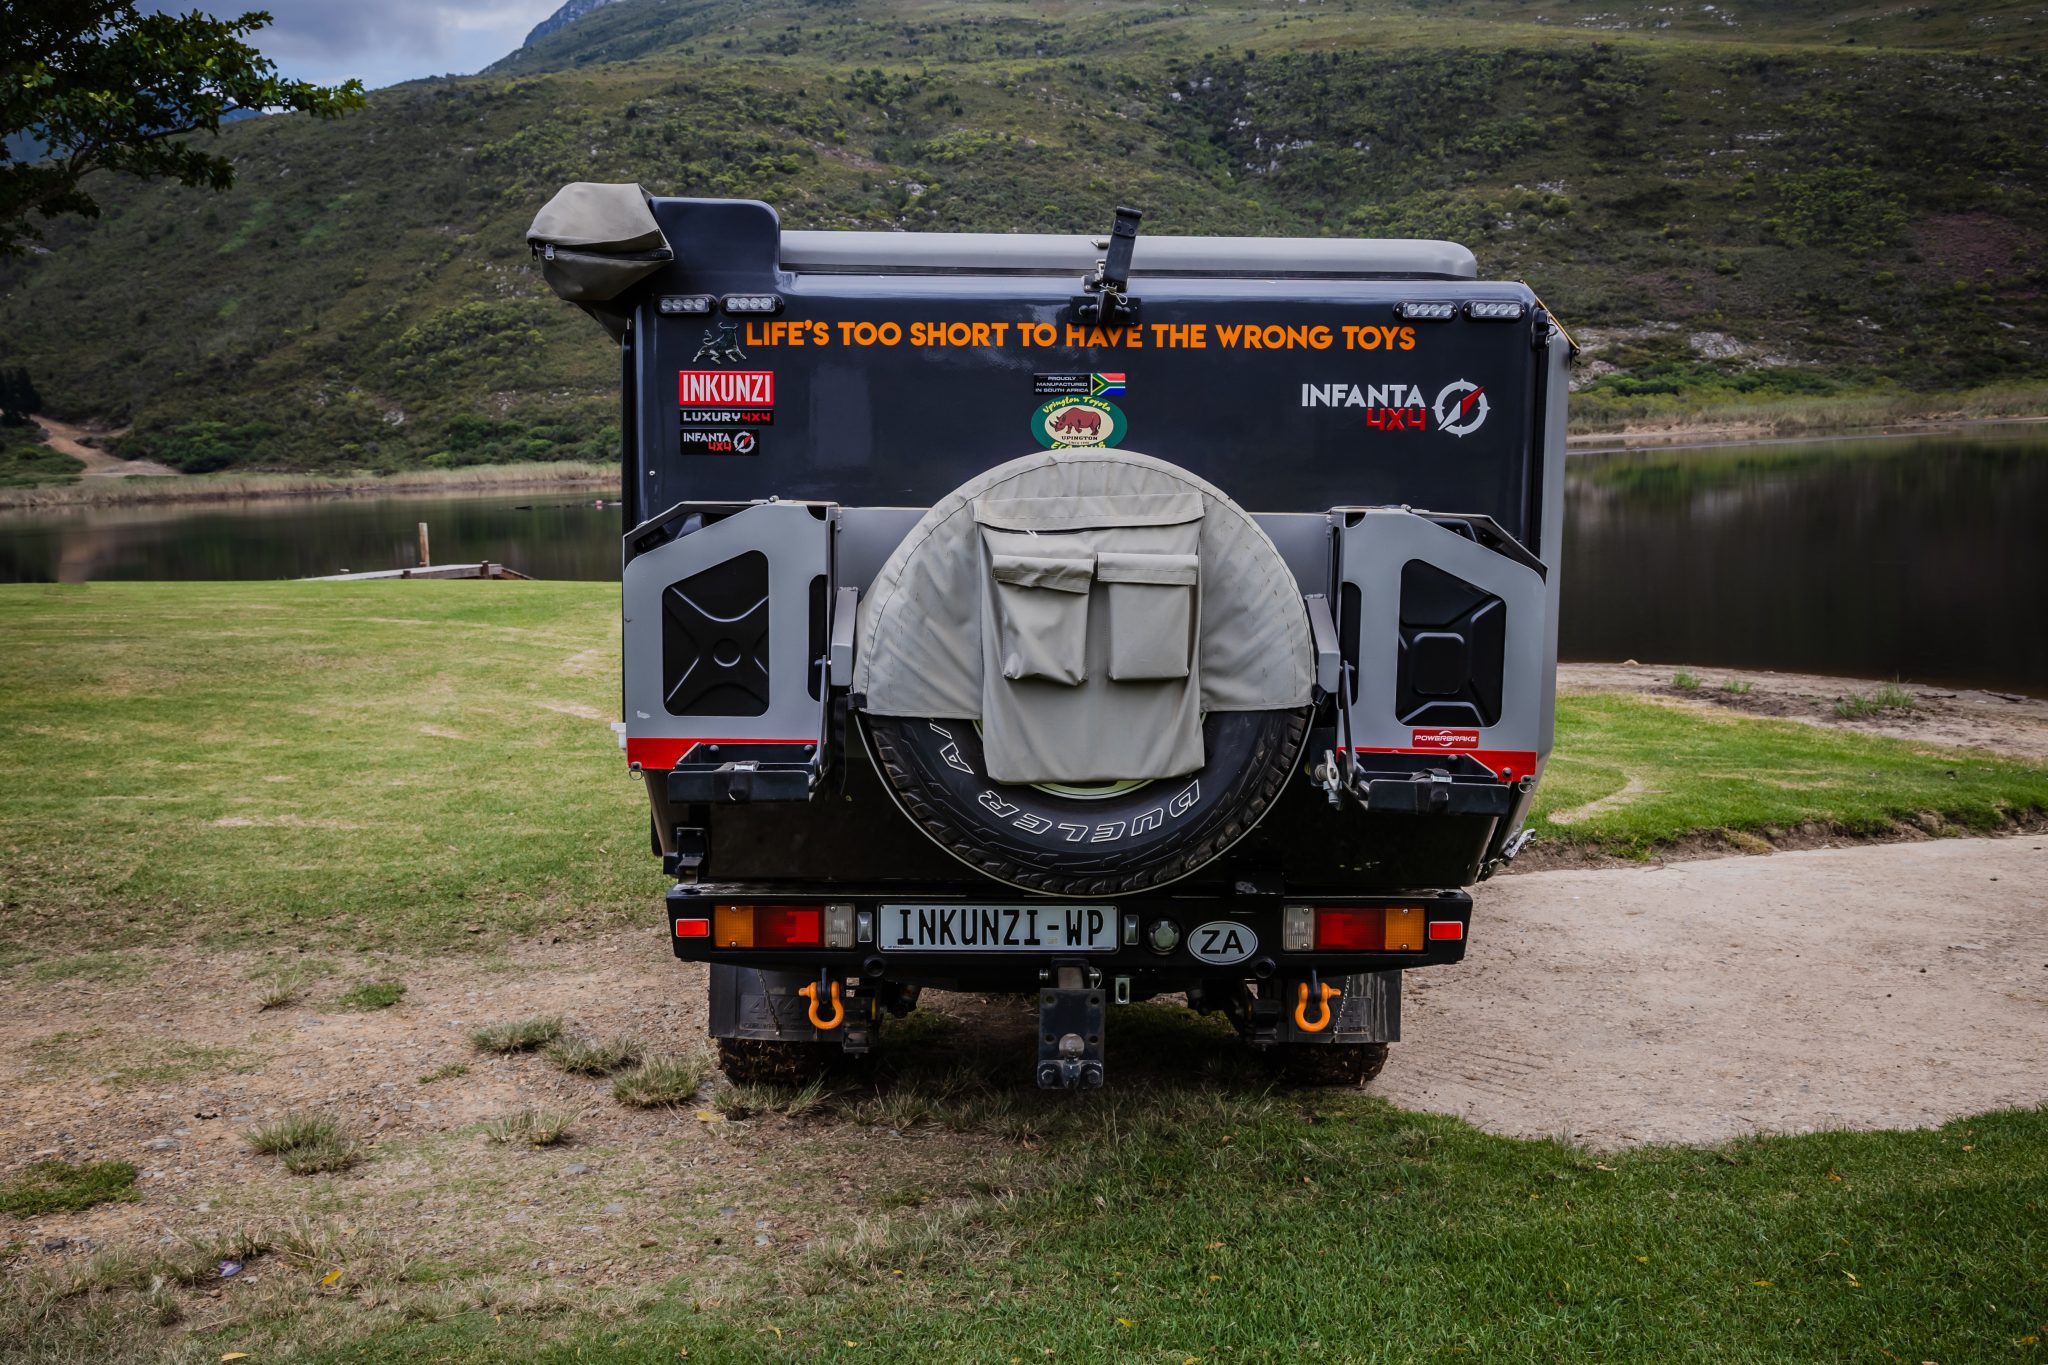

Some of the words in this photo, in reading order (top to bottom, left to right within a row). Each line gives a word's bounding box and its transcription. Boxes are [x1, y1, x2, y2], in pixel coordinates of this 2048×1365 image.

[746, 319, 830, 346] LIFE'S
[837, 321, 902, 346] TOO
[910, 321, 1009, 347] SHORT
[1017, 322, 1058, 347] TO
[1065, 323, 1143, 348] HAVE
[1151, 323, 1207, 348] THE
[1215, 324, 1334, 349] WRONG
[1341, 325, 1416, 351] TOYS
[683, 374, 771, 402] INKUNZI
[1301, 383, 1426, 408] INFANTA
[1042, 396, 1080, 413] Upington
[1082, 396, 1111, 412] Toyota
[1366, 407, 1427, 431] 4X4
[683, 432, 731, 443] INFANTA
[708, 442, 732, 452] 4X4
[1414, 734, 1477, 743] POWERBRAKE
[978, 779, 1200, 843] DUELER
[1199, 929, 1245, 955] ZA
